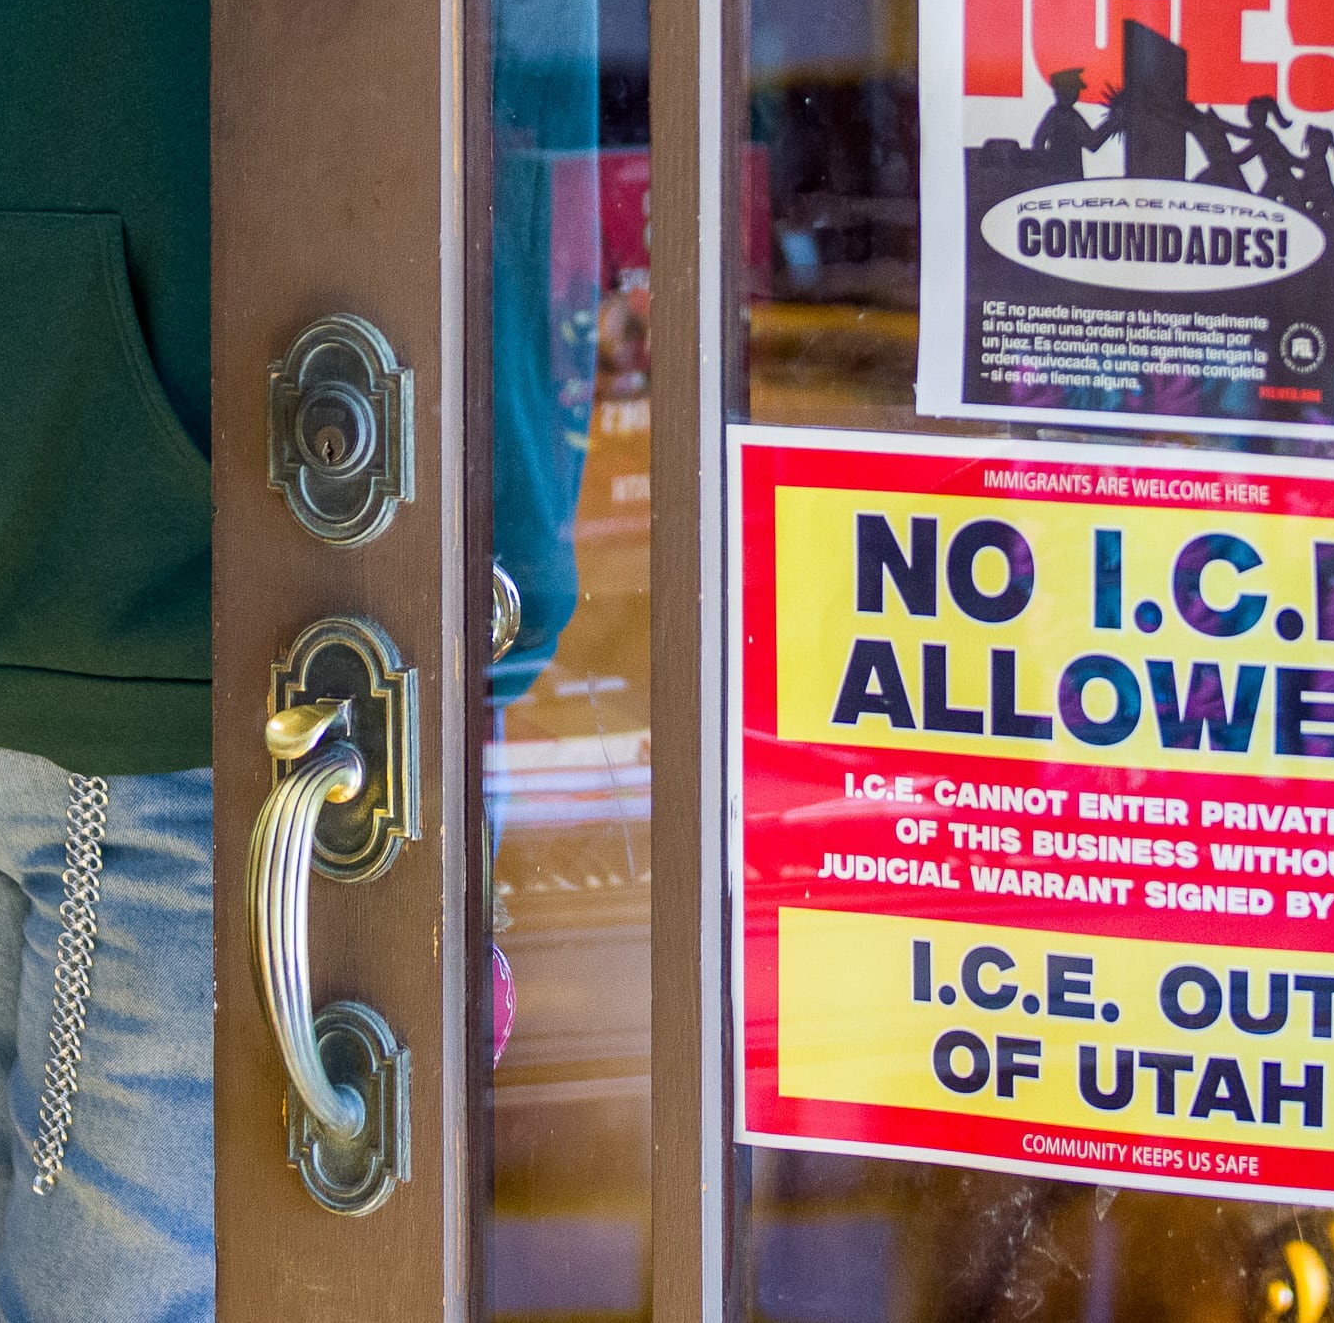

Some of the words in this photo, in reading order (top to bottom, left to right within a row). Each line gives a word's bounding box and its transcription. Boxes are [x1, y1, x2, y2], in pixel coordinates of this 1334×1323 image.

[1058, 197, 1130, 210] FUERA
[1135, 198, 1164, 209] DE
[1168, 200, 1286, 223] NUESTRAS
[1017, 216, 1288, 270] COMUNIDADES!
[982, 300, 1006, 316] ICE
[1008, 304, 1026, 317] no
[1028, 304, 1068, 320] puede
[1071, 305, 1125, 324] ingresar
[1126, 310, 1136, 323] a
[1137, 309, 1151, 323] tu
[1153, 310, 1192, 328] hogar
[1193, 312, 1269, 331] legalmente
[982, 317, 995, 332] si
[996, 320, 1015, 333] no
[1015, 319, 1056, 335] tienen
[1058, 324, 1084, 337] una
[1085, 323, 1124, 338] orden
[1126, 325, 1172, 341] judicial
[1174, 328, 1225, 345] firmada
[1226, 333, 1252, 347] por
[981, 352, 1020, 366] orden
[1102, 359, 1113, 370] o
[1114, 360, 1140, 374] una
[1141, 361, 1181, 375] orden
[1183, 364, 1201, 377] no
[1202, 365, 1267, 381] completa
[982, 336, 1000, 348] un
[1034, 336, 1051, 351] Es
[1053, 339, 1100, 353] común
[1101, 344, 1126, 358] que
[1128, 343, 1148, 357] los
[1150, 345, 1204, 362] agentes
[1205, 346, 1253, 363] tengan
[1254, 348, 1268, 363] la
[990, 367, 1004, 382] si
[1004, 370, 1020, 383] es
[1022, 372, 1048, 387] que
[1050, 371, 1090, 385] tienen
[984, 469, 1092, 495] IMMIGRANTS
[1095, 476, 1128, 497] ARE
[1132, 477, 1221, 502] WELCOME
[1225, 483, 1271, 505] HERE
[855, 514, 1035, 623] NO
[844, 772, 923, 804] I.C.E.
[934, 780, 1068, 816] CANNOT
[1078, 792, 1188, 826] ENTER
[895, 817, 938, 845] OF
[948, 822, 1022, 855] THIS
[1032, 829, 1199, 869] BUSINESS
[817, 852, 961, 890] JUDICIAL
[969, 864, 1134, 906] WARRANT
[1145, 880, 1274, 918] SIGNED
[912, 939, 1121, 1024] I.C.E.
[932, 1029, 1042, 1099] OF
[1078, 1044, 1326, 1129] UTAH
[1022, 1133, 1128, 1162] COMMUNITY
[1132, 1146, 1184, 1169] KEEPS
[1188, 1151, 1211, 1172] US
[1216, 1154, 1259, 1177] SAFE
